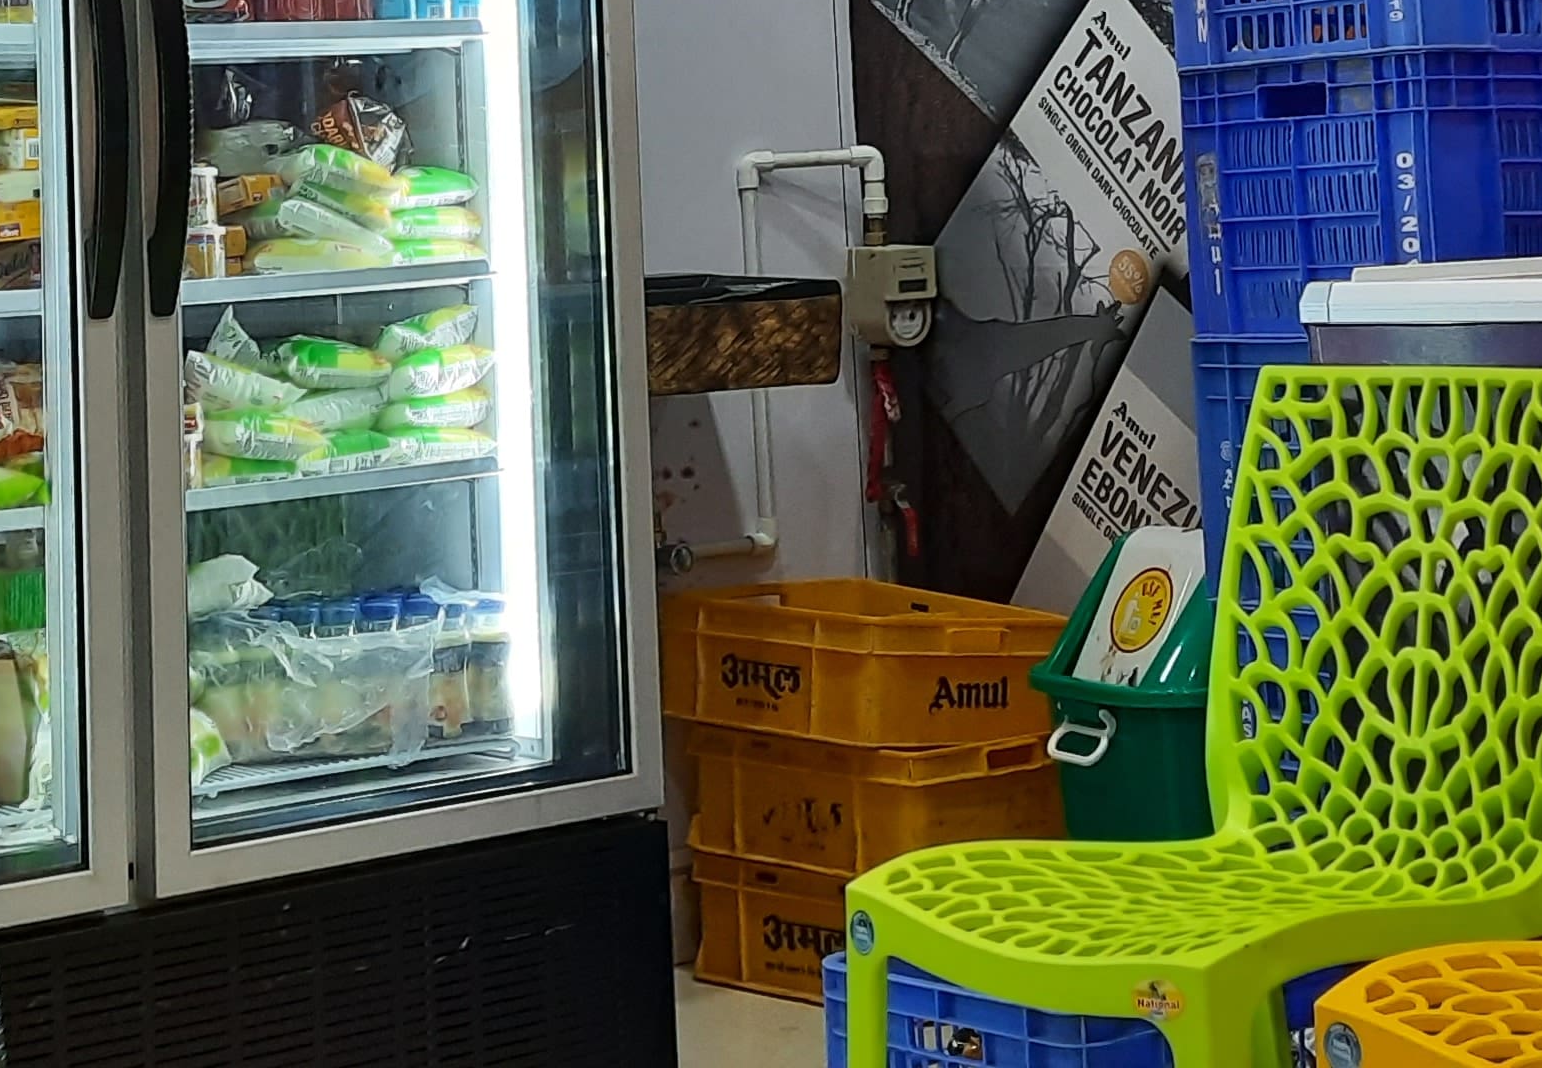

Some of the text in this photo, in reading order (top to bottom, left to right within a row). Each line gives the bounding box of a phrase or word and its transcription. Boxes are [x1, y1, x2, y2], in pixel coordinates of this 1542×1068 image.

[1091, 9, 1132, 63] Amul
[1073, 26, 1187, 205] TANZANI
[1037, 94, 1067, 138] SINGLE
[1090, 165, 1114, 201] DARK
[1111, 194, 1160, 261] CHOCOLATE
[1052, 64, 1188, 247] CHOCOLAT NOIR
[1112, 401, 1158, 451] Amul
[1071, 491, 1104, 532] SINGLE
[928, 675, 1009, 715] Amul
